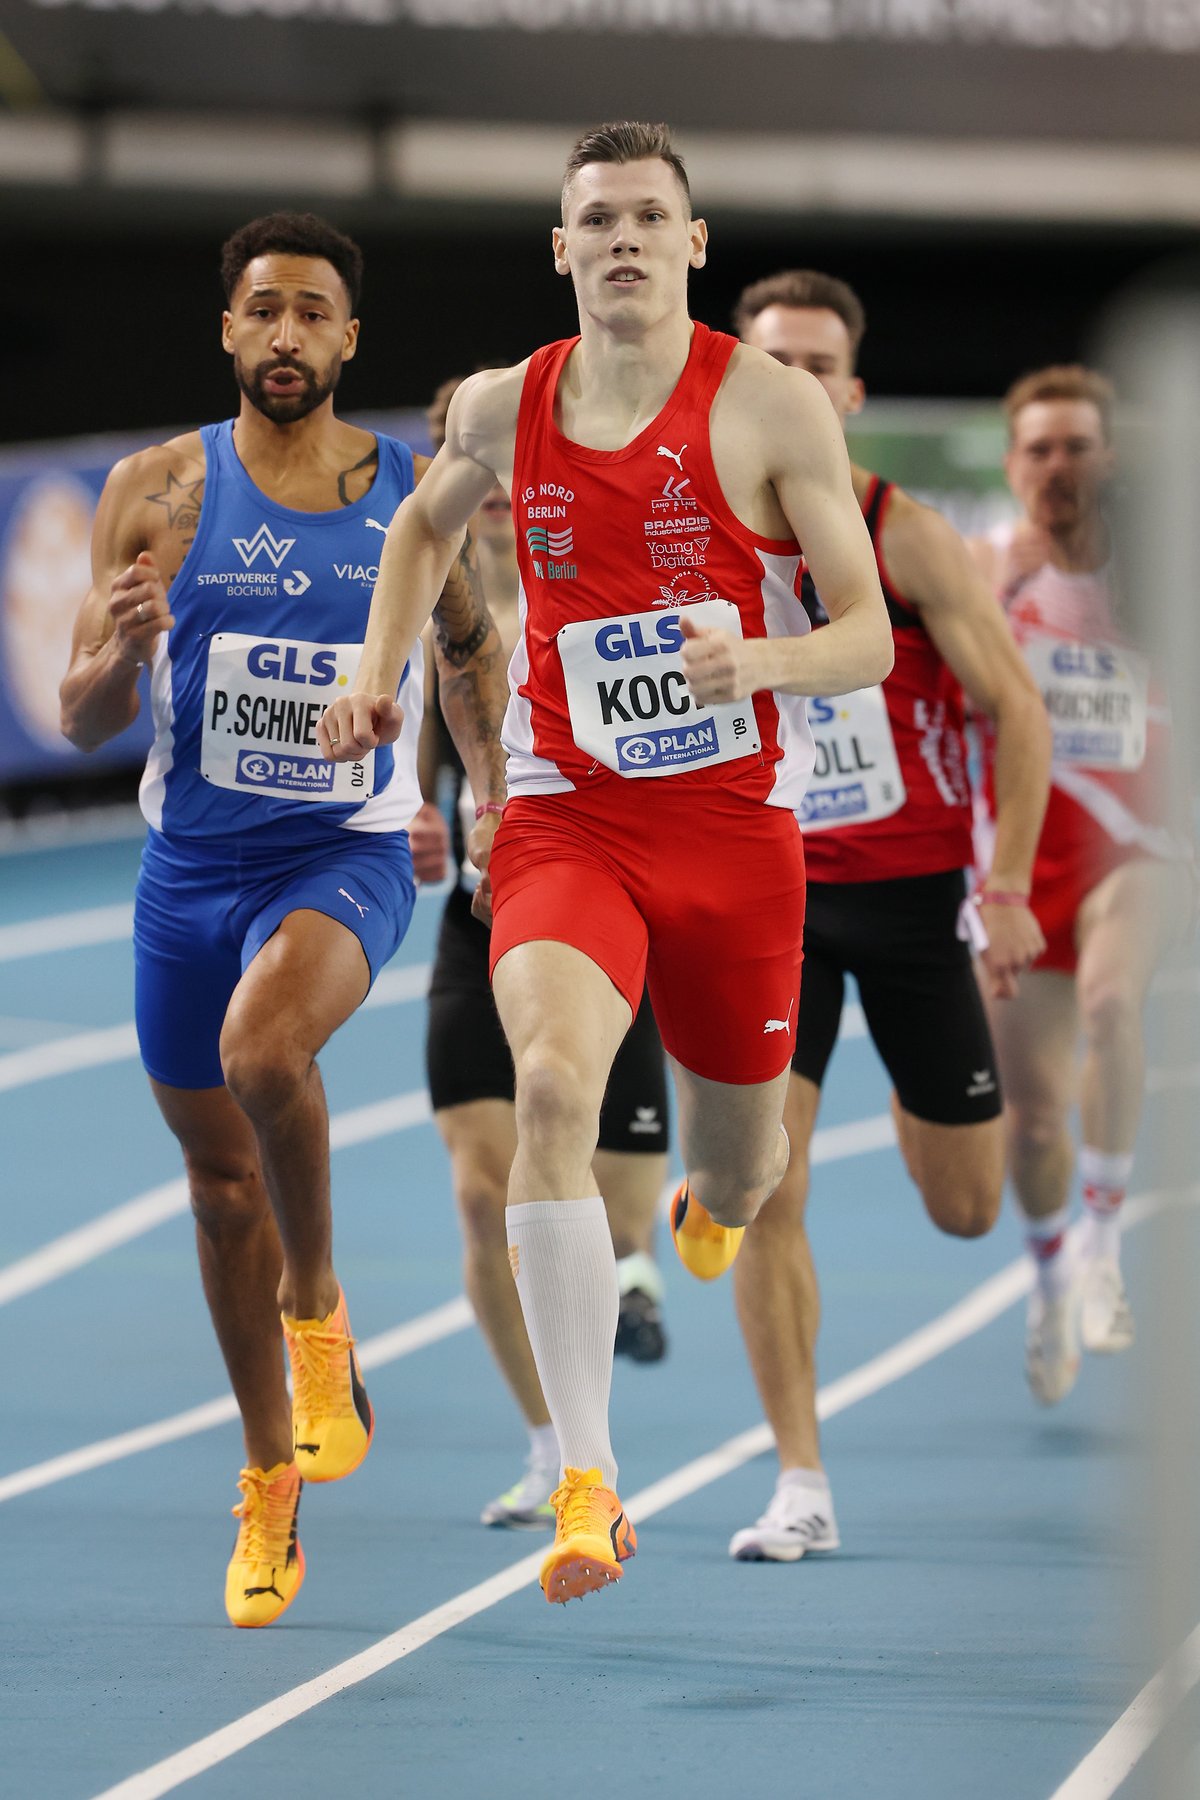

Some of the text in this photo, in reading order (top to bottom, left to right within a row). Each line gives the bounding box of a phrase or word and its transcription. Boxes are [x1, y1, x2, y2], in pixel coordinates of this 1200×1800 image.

[522, 483, 574, 504] LG NORD
[528, 506, 566, 519] BERLIN
[644, 517, 710, 530] BRANDIS
[645, 524, 711, 536] industrial design
[646, 541, 694, 555] Young
[651, 552, 706, 569] Digitals
[547, 560, 577, 580] Berlin
[197, 573, 278, 586] STADTWERKE
[226, 585, 278, 597] BOCHUM
[597, 671, 704, 726] KOC
[211, 690, 328, 746] P.SCHNE
[659, 727, 713, 753] PLAN
[661, 745, 715, 761] INTERNATIONAL
[277, 761, 332, 780] PLAN
[351, 762, 364, 787] 470
[276, 779, 330, 788] INTERNATIONAL
